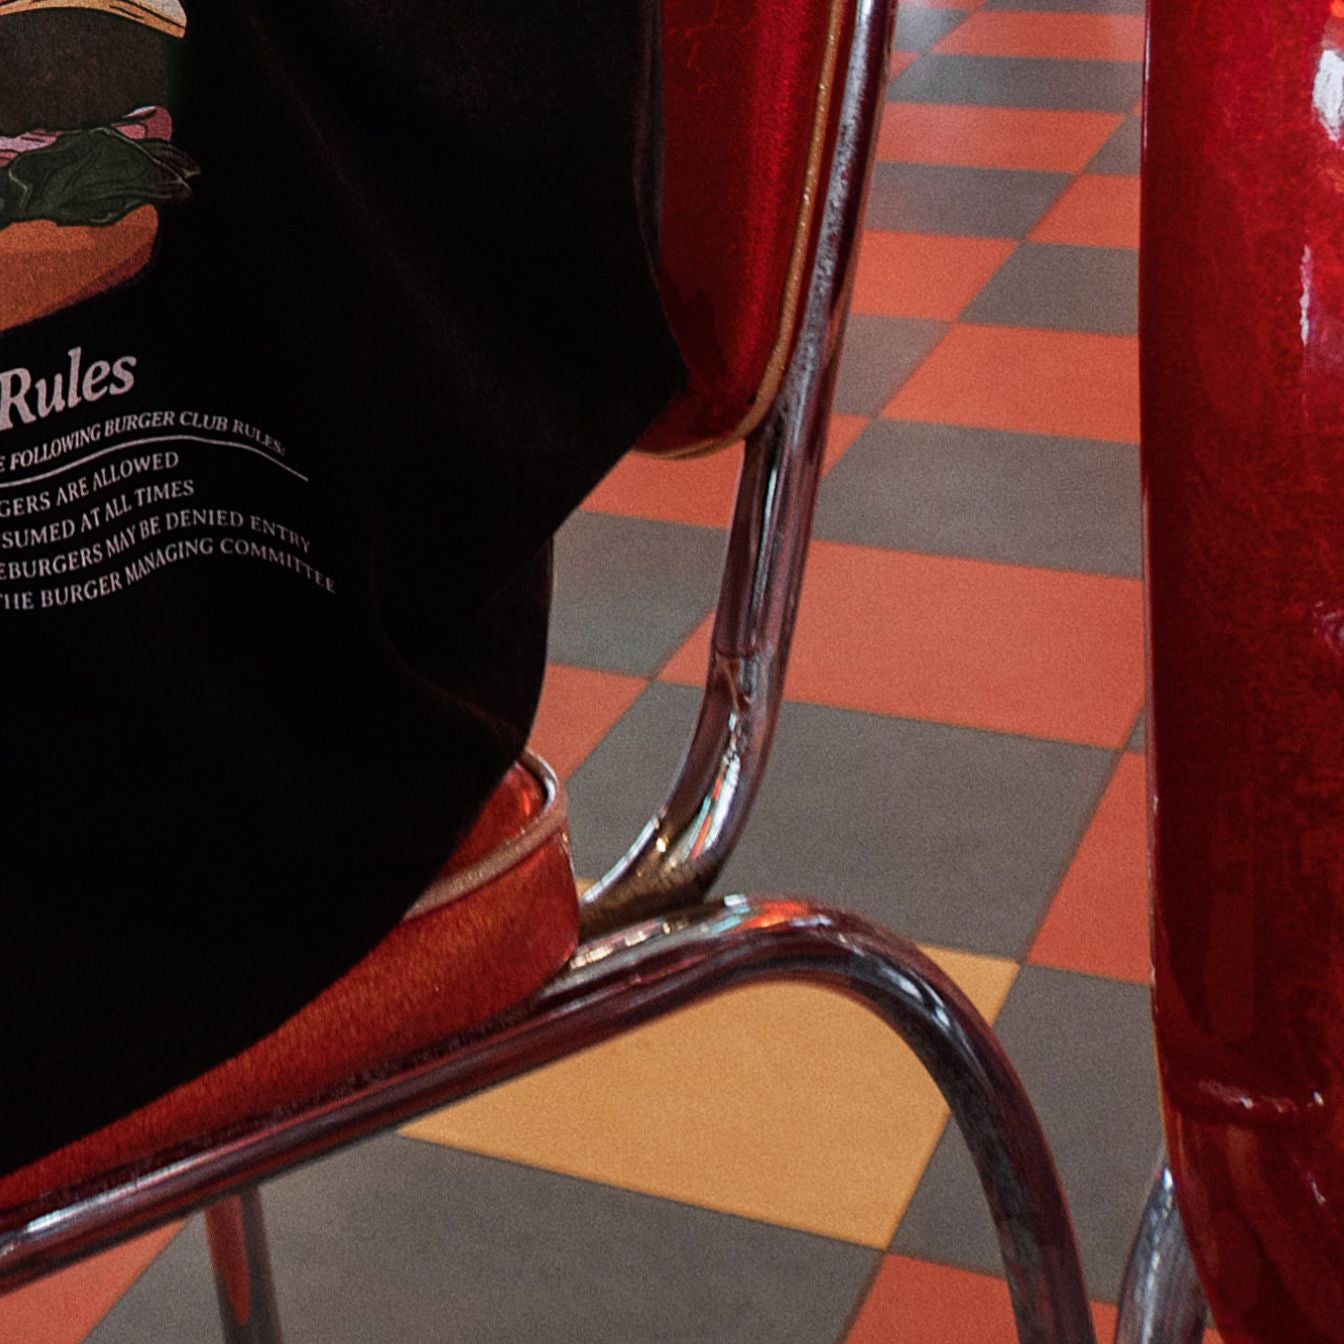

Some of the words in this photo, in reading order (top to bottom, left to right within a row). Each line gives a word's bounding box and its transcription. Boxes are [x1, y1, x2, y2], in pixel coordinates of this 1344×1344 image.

[10, 424, 100, 470] FOLLOWING
[105, 411, 175, 437] BURGER
[180, 412, 228, 430] CLUB
[57, 477, 89, 506] ARE
[93, 452, 180, 492] ALLOWED
[81, 507, 99, 532] AT
[106, 495, 131, 521] ALL
[135, 480, 194, 506] TIMES
[106, 525, 135, 557] MAY
[140, 516, 159, 539] BE
[166, 510, 243, 530] DENIED
[251, 516, 311, 554] ENTRY
[41, 572, 122, 607] BURGER
[125, 537, 213, 584] MANAGING
[220, 538, 336, 594] COMMITTEE
